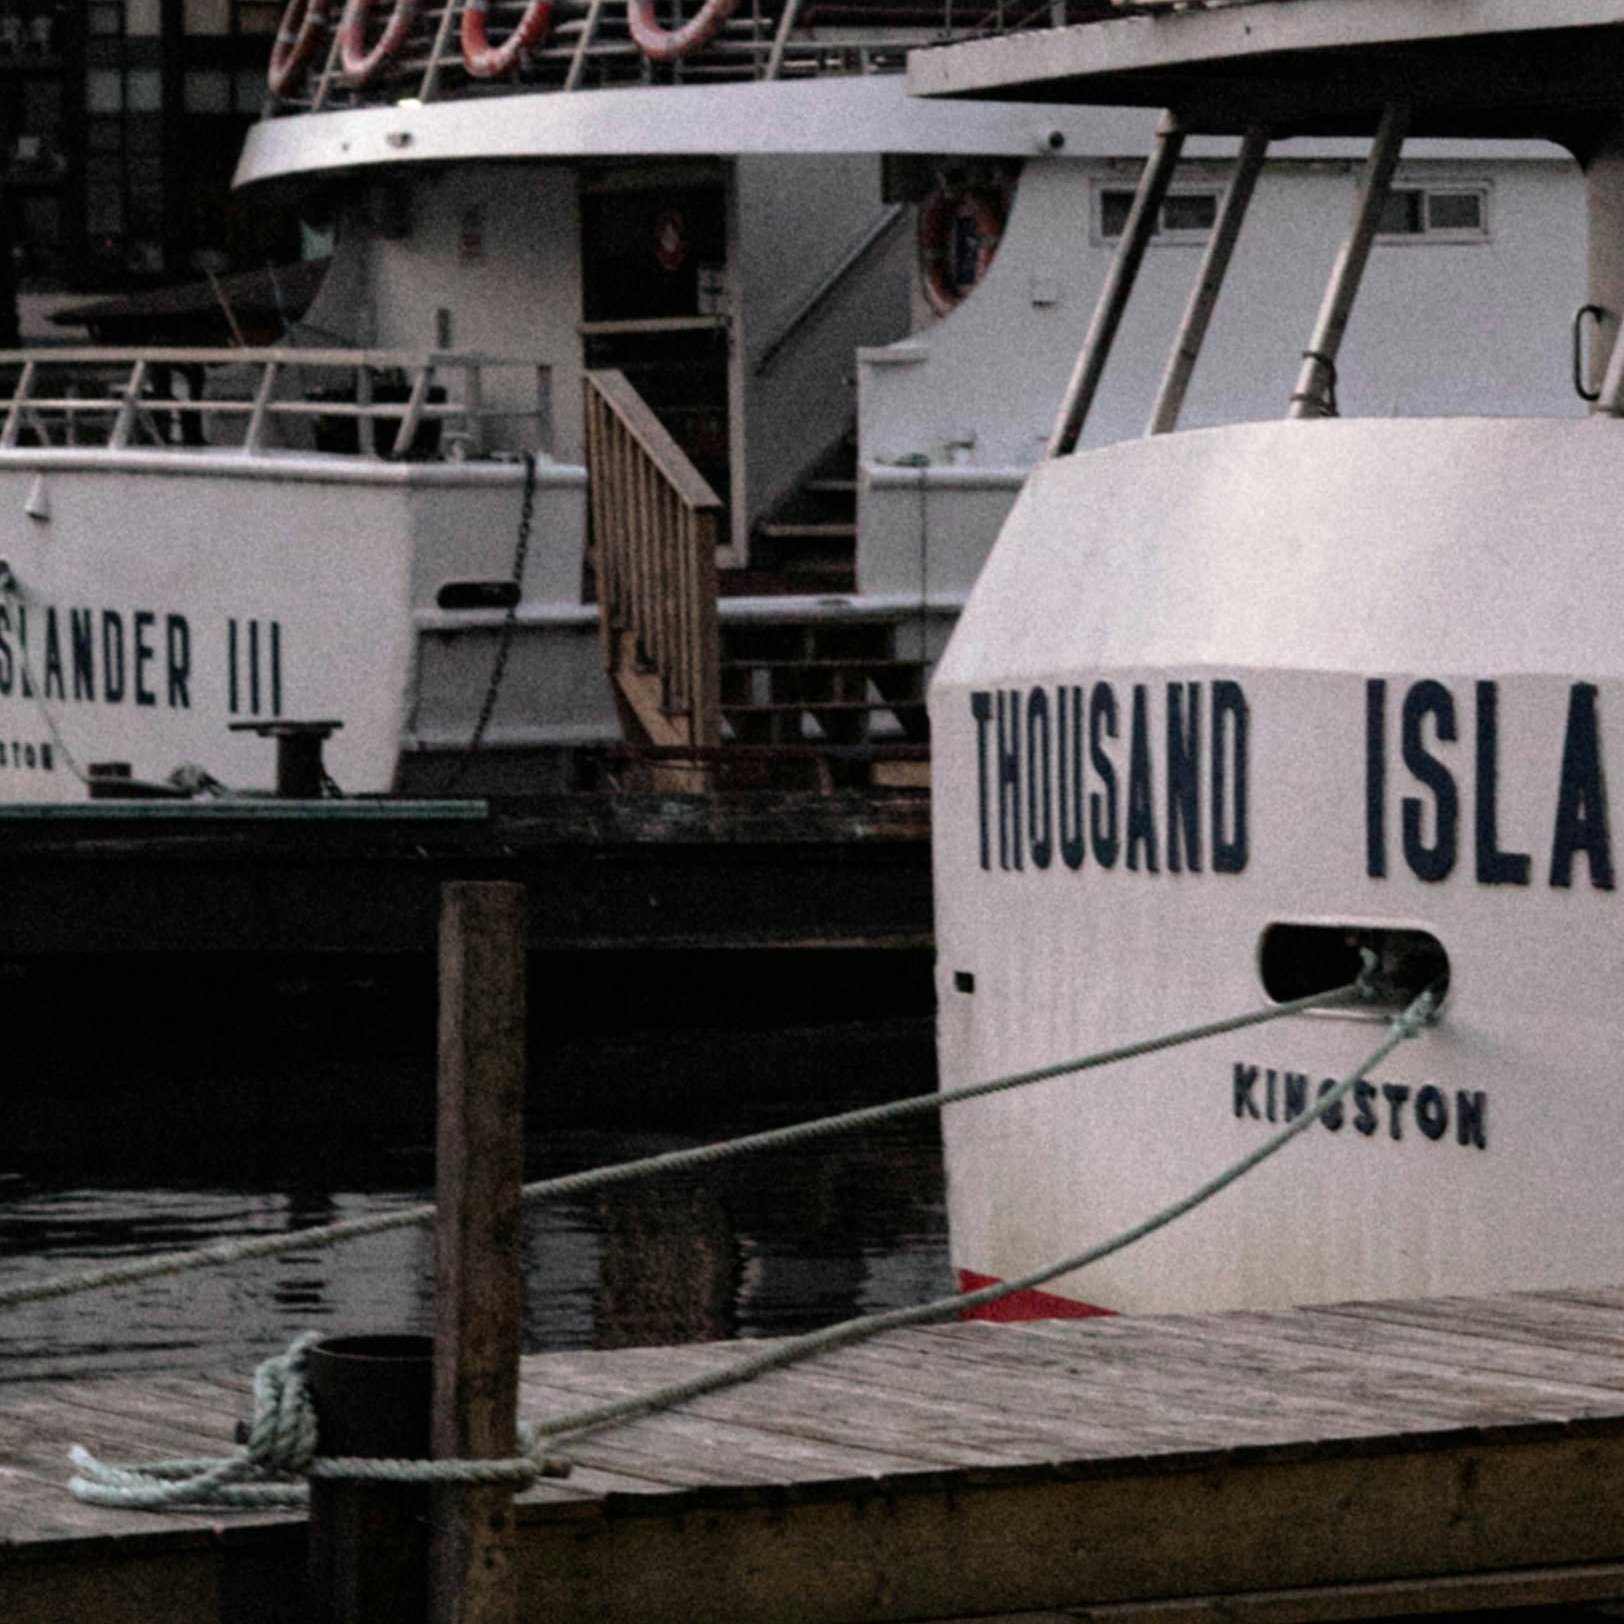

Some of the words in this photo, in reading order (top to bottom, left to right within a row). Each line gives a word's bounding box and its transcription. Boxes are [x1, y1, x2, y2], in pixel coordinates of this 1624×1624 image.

[227, 617, 283, 719] III
[969, 679, 1250, 875] THOUSAND
[1231, 1063, 1489, 1149] KINGSTON
